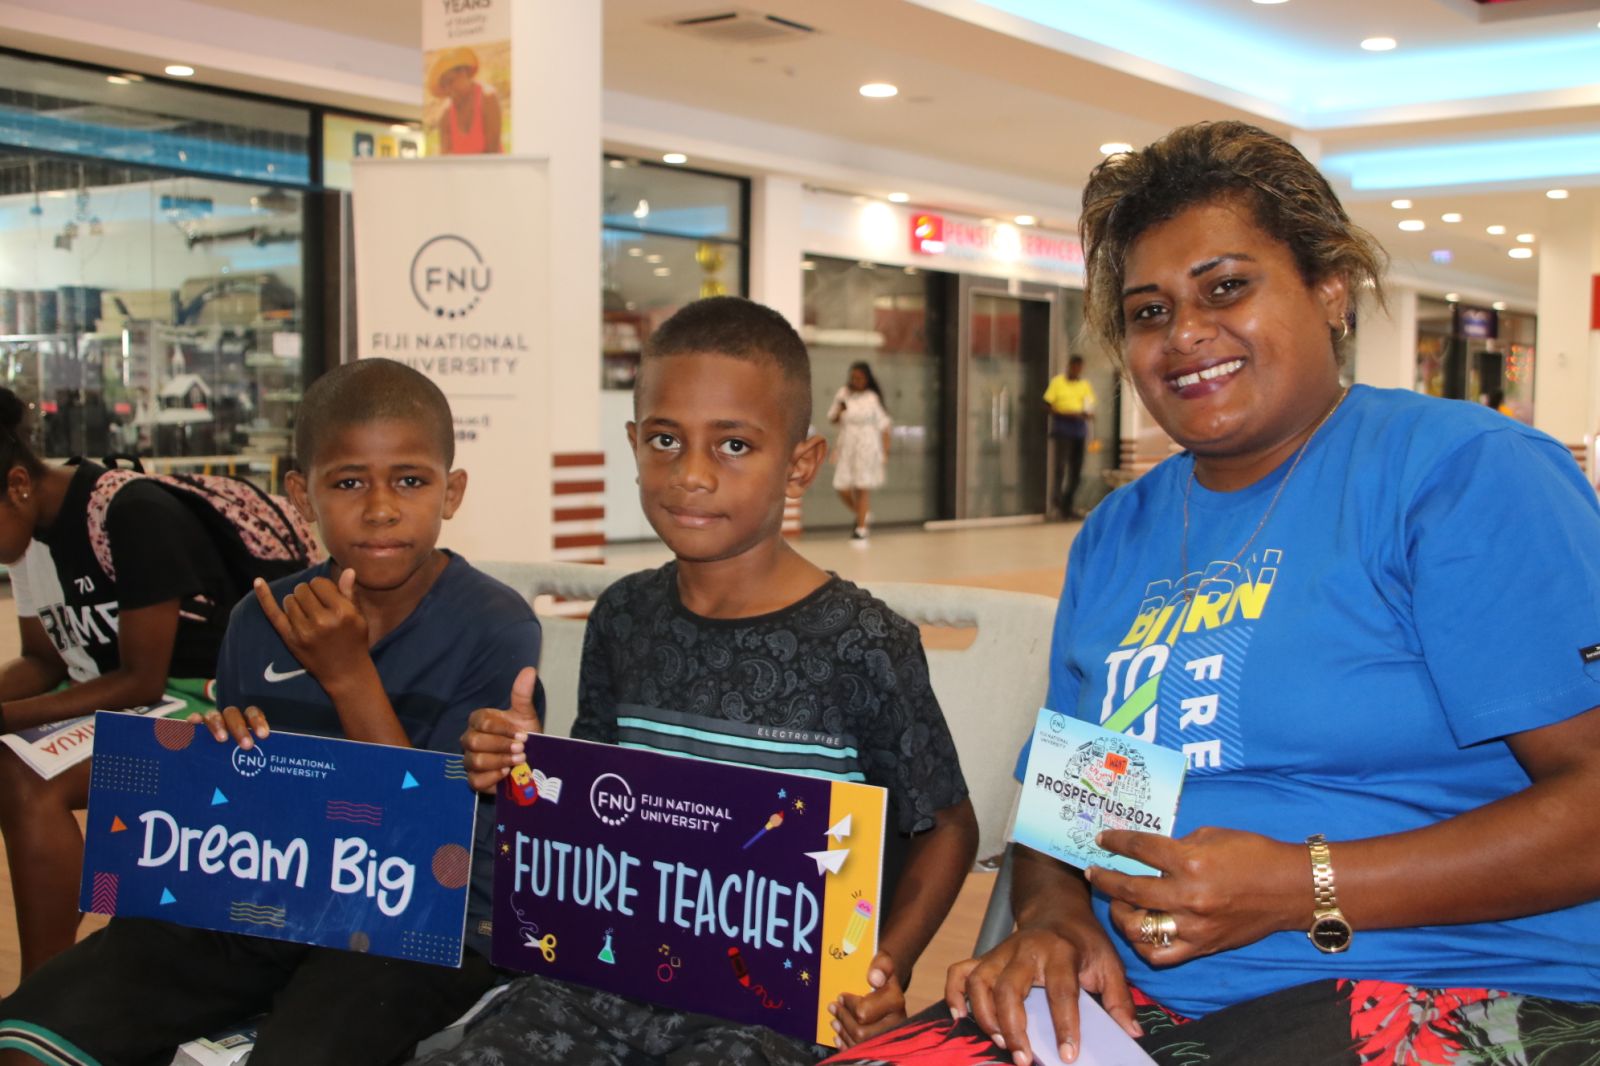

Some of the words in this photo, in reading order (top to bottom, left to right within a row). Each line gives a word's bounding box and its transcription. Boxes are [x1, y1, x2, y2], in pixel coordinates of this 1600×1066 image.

[425, 266, 491, 293] FNU
[371, 332, 409, 350] FIJI
[416, 333, 529, 352] NATIONAL
[74, 575, 95, 595] 70
[757, 727, 809, 741] ELECTRO
[814, 733, 840, 746] VIBE
[238, 754, 267, 768] FNU
[269, 765, 328, 779] UNIVERSITY
[270, 754, 287, 765] FIJI
[288, 757, 337, 771] NATIONAL
[598, 791, 636, 813] FNU
[641, 793, 664, 808] FIJI
[665, 798, 733, 820] NATIONAL
[1036, 773, 1124, 817] PROSPECTUS
[1125, 806, 1162, 832] 2024
[640, 808, 720, 833] UNIVERSITY
[137, 809, 309, 888] Dream
[330, 836, 416, 917] Big
[514, 830, 641, 917] FUTURE
[652, 860, 820, 955] TEACHER
